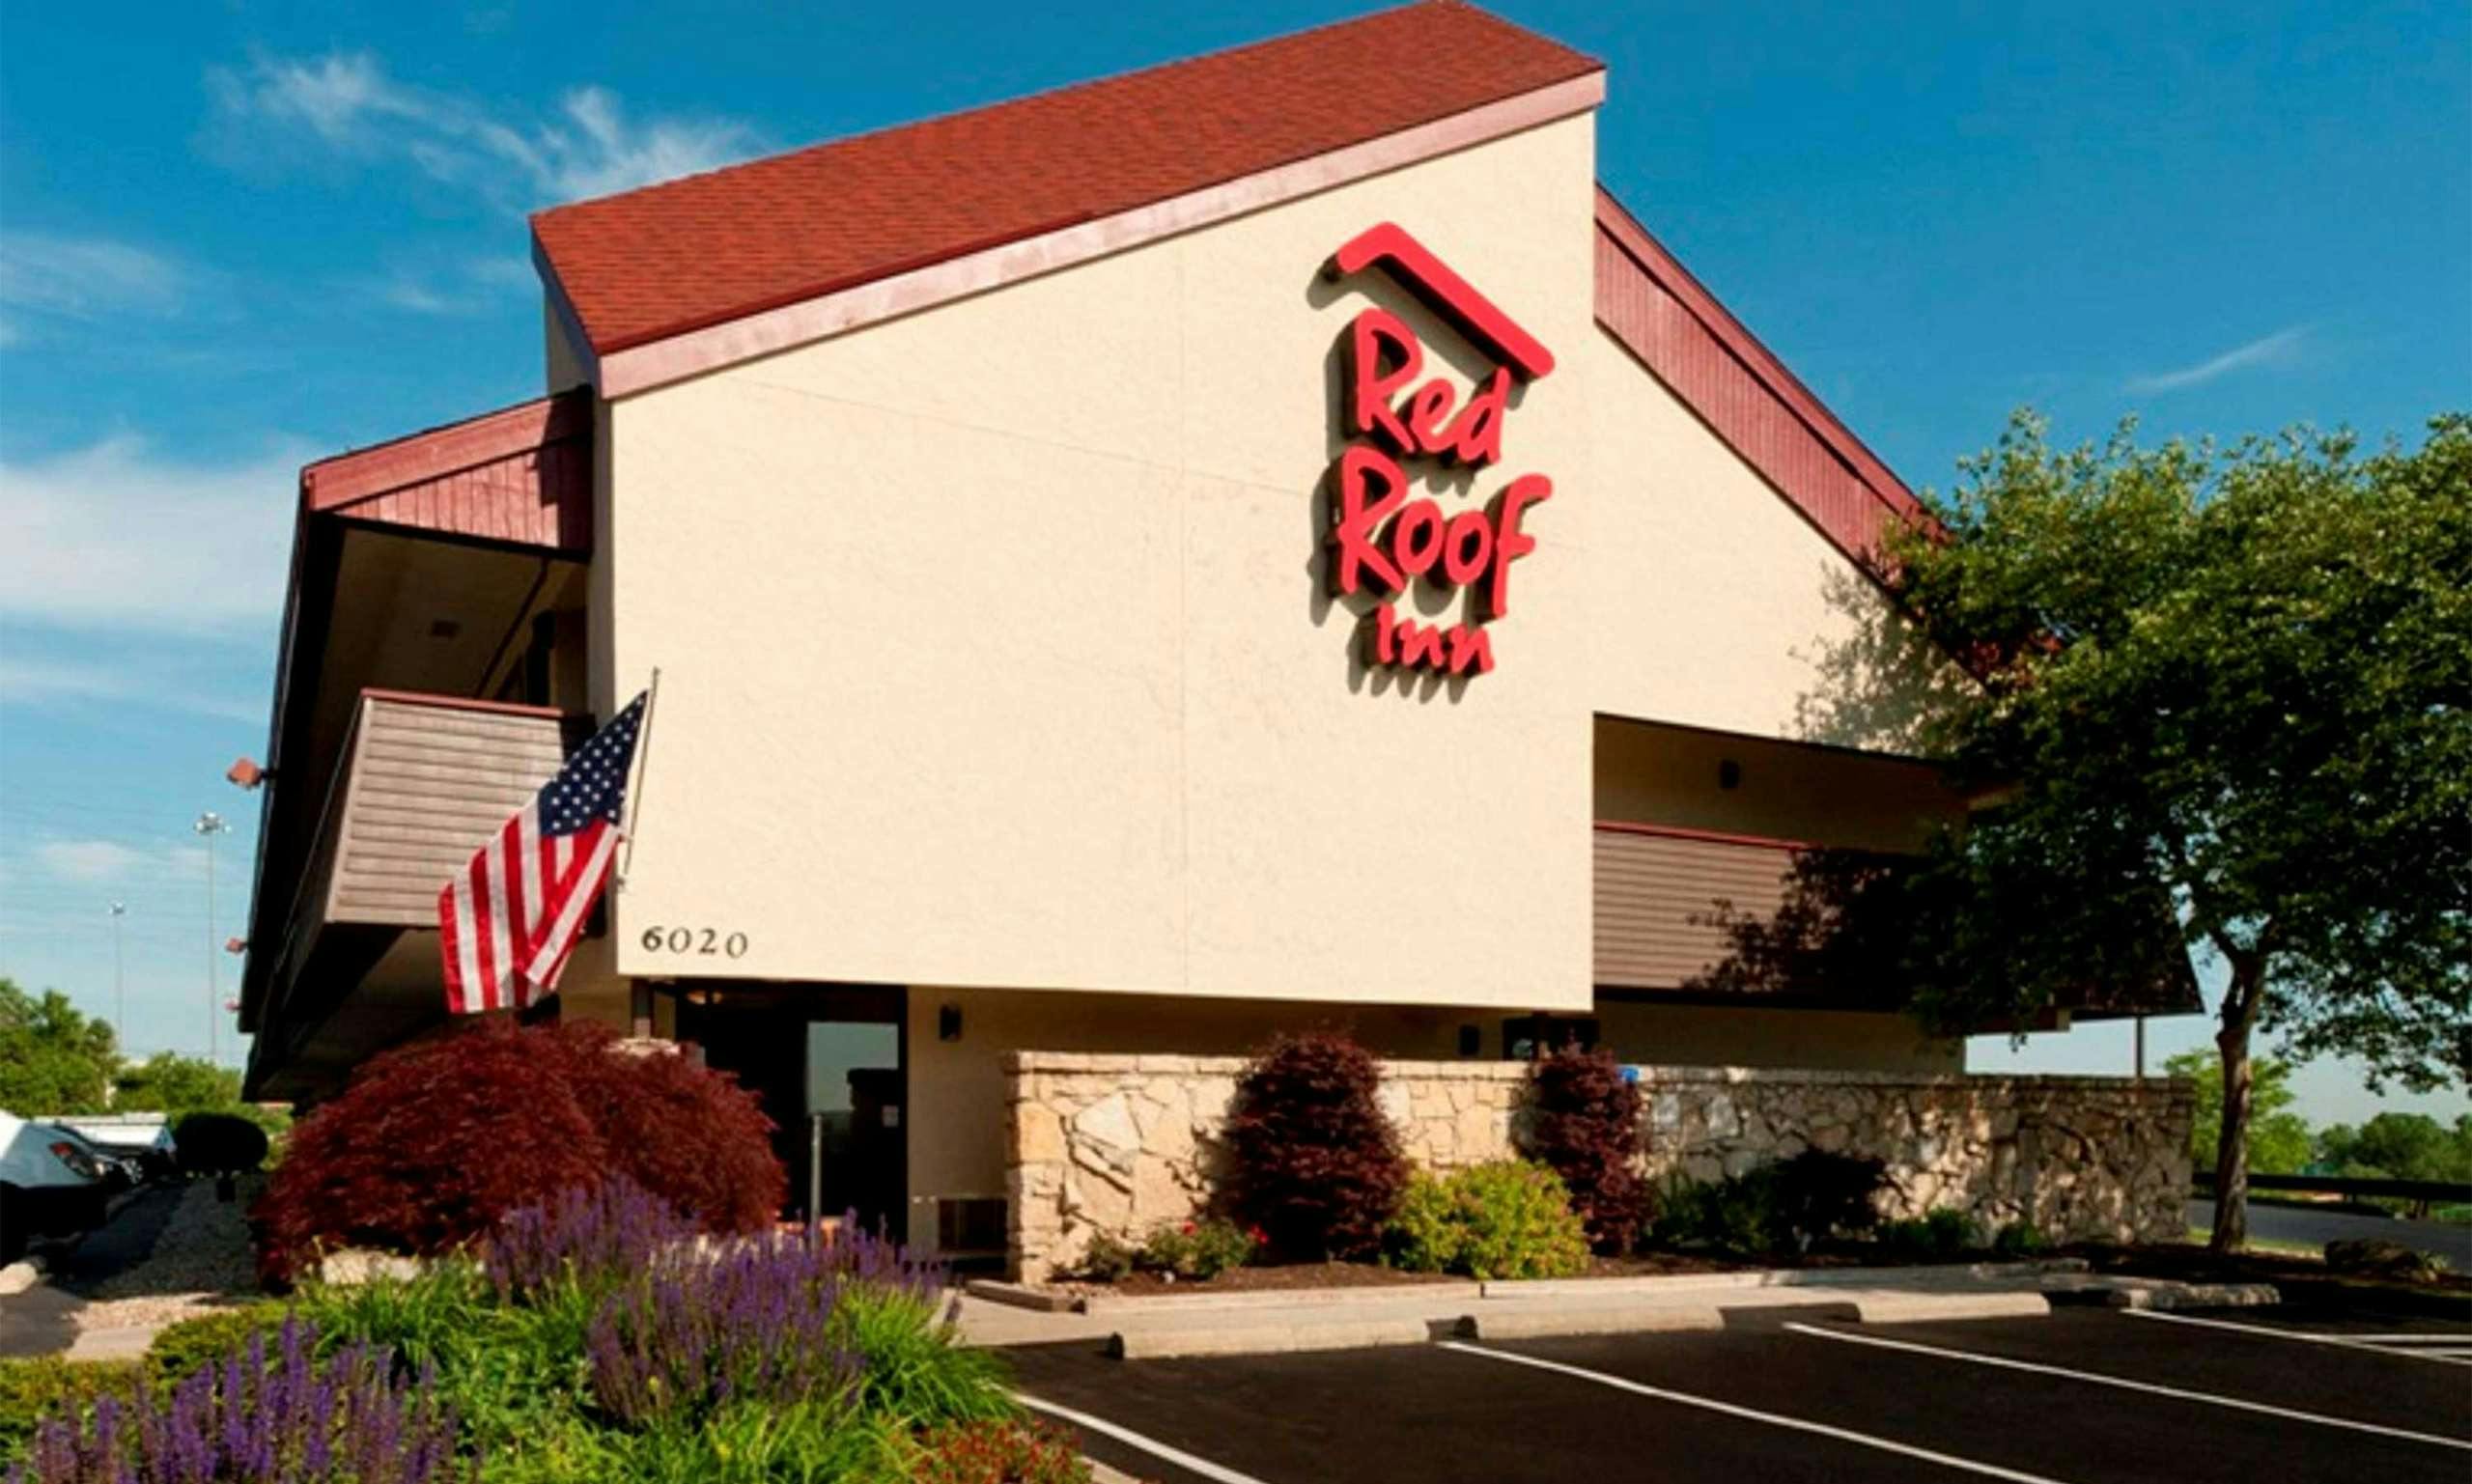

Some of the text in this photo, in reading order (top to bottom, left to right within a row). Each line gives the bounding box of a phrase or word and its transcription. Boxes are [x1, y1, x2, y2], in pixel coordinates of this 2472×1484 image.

[1354, 308, 1510, 463] Red
[1337, 445, 1553, 618] Roof
[1377, 602, 1494, 674] Inn
[641, 926, 748, 959] 6020
